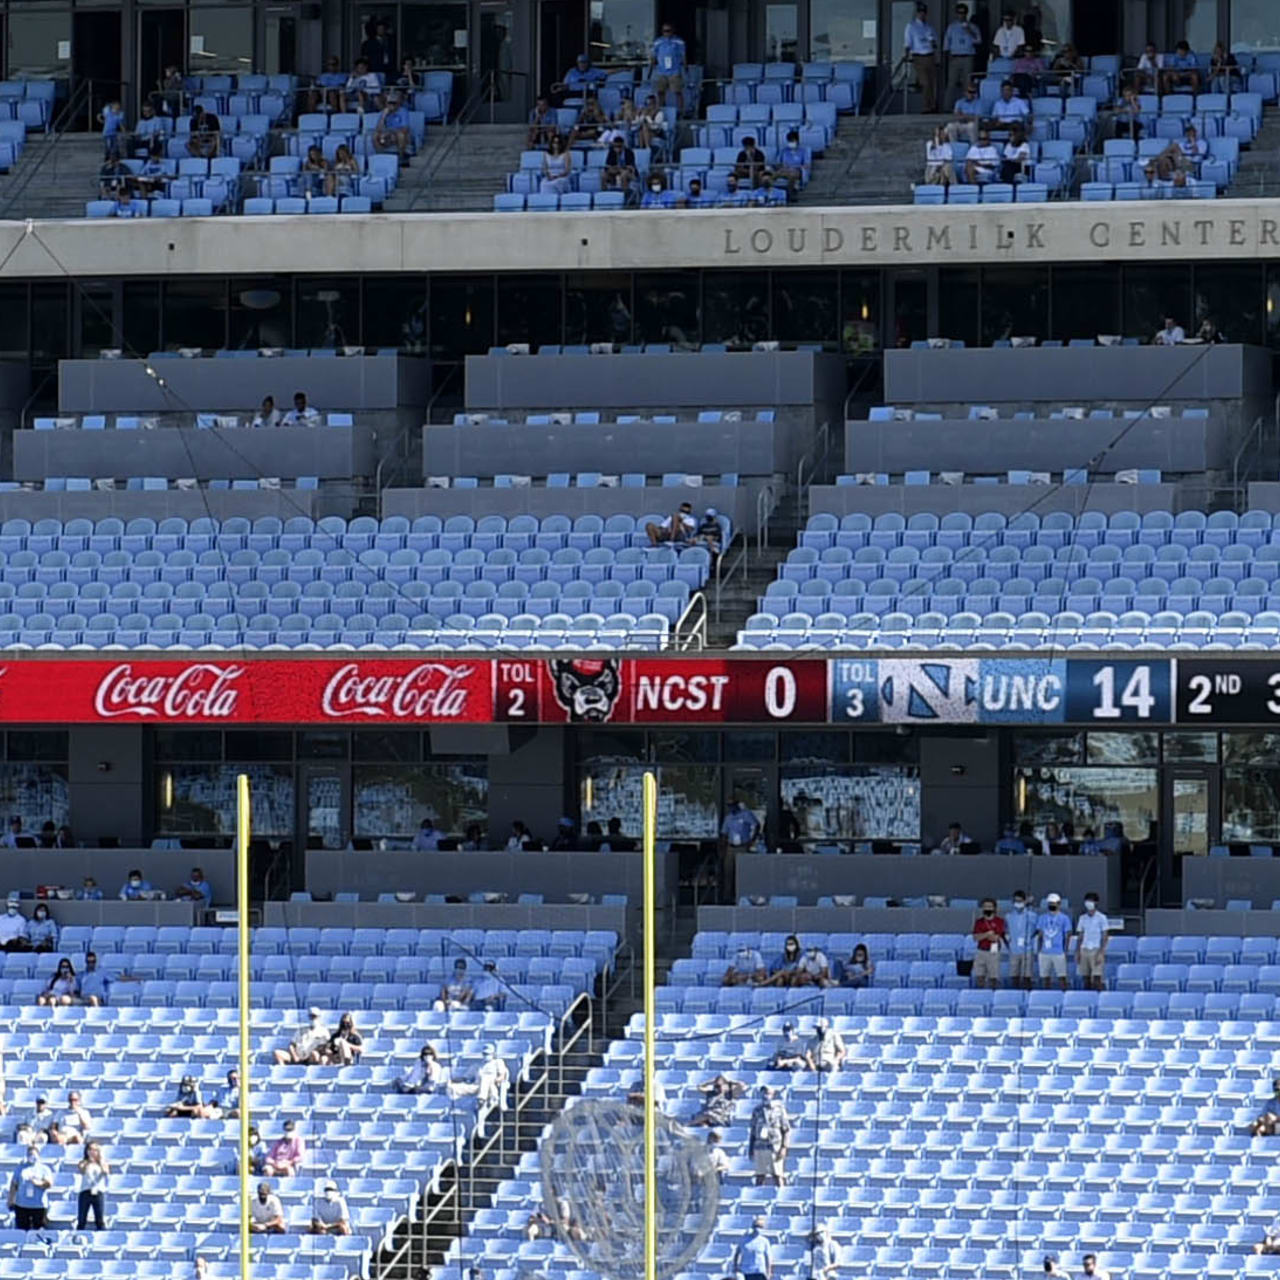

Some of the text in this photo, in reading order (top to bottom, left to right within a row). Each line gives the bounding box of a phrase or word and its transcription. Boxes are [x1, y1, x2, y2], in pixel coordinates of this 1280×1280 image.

[723, 218, 1048, 256] LOUDERMILK
[94, 663, 248, 718] Coca-Cola
[321, 663, 476, 718] Coca-Cola
[500, 663, 535, 683] TOL
[635, 673, 730, 711] NCST
[763, 666, 797, 718] 0
[840, 663, 876, 683] TOL
[982, 673, 1062, 711] UNC
[1092, 666, 1154, 718] 14
[507, 688, 525, 717] 2
[845, 687, 865, 717] 3
